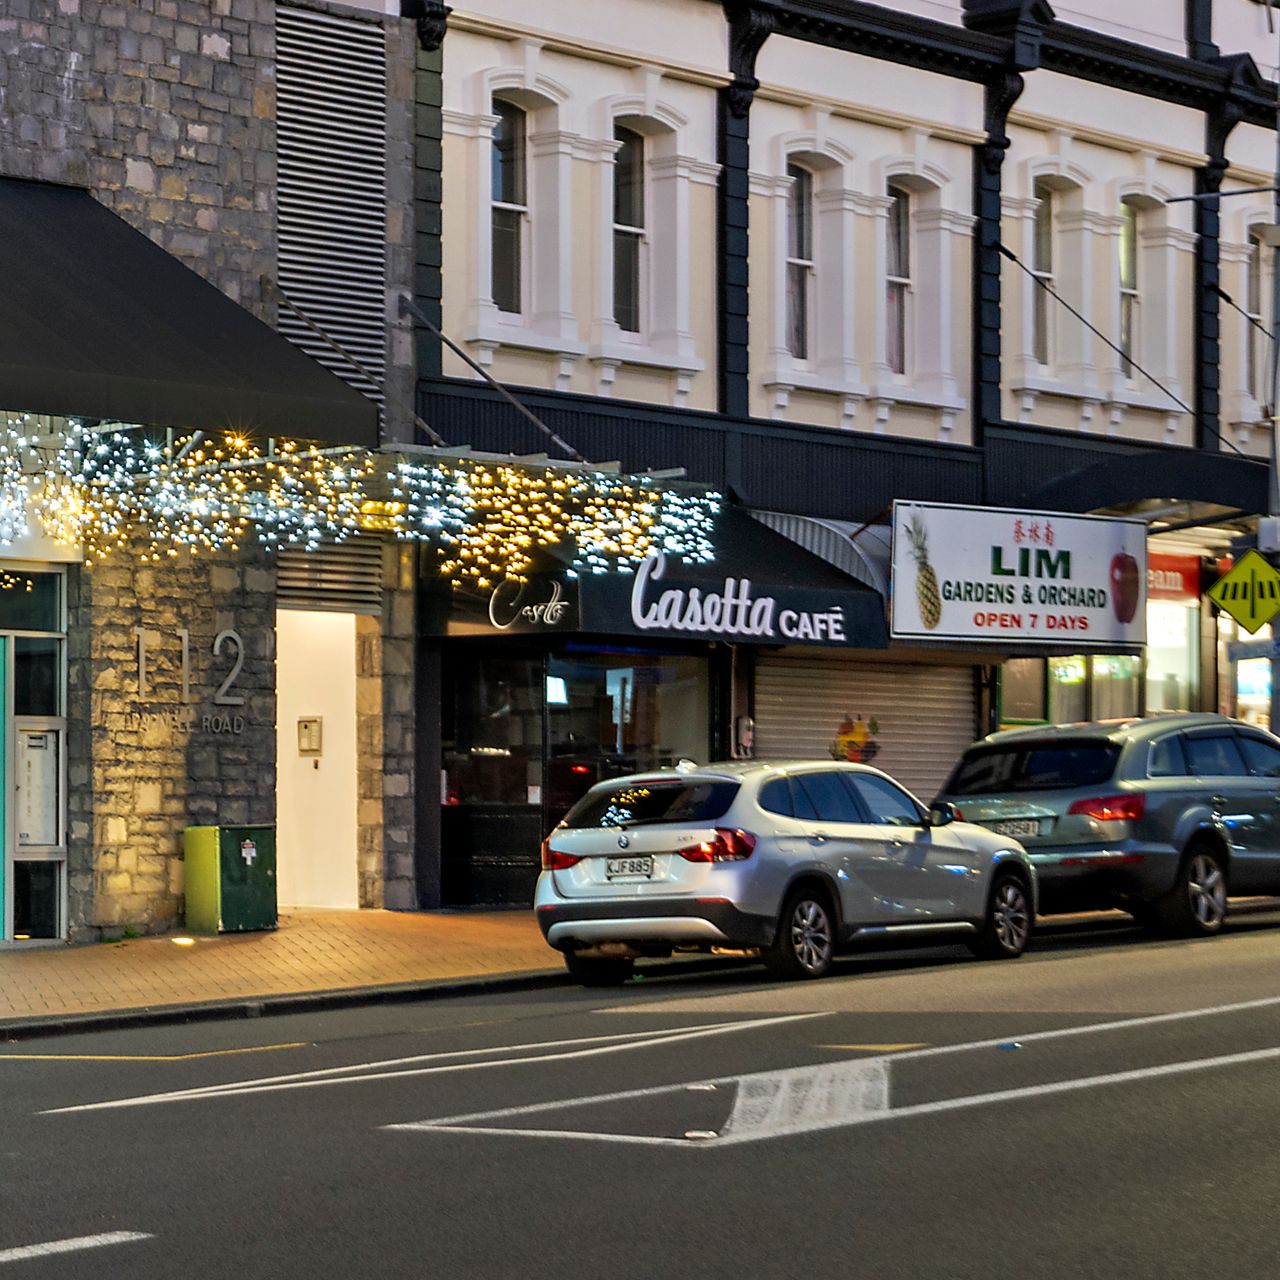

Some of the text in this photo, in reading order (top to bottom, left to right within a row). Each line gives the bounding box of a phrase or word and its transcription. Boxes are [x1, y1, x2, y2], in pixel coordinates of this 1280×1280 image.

[991, 546, 1071, 579] LIM
[631, 549, 847, 641] Casetta CAFÉ
[942, 580, 1107, 608] GARDENS & ORCHARD
[973, 612, 1088, 630] OPEN 7 DAYS
[134, 627, 245, 705] 112
[202, 716, 244, 734] ROAD
